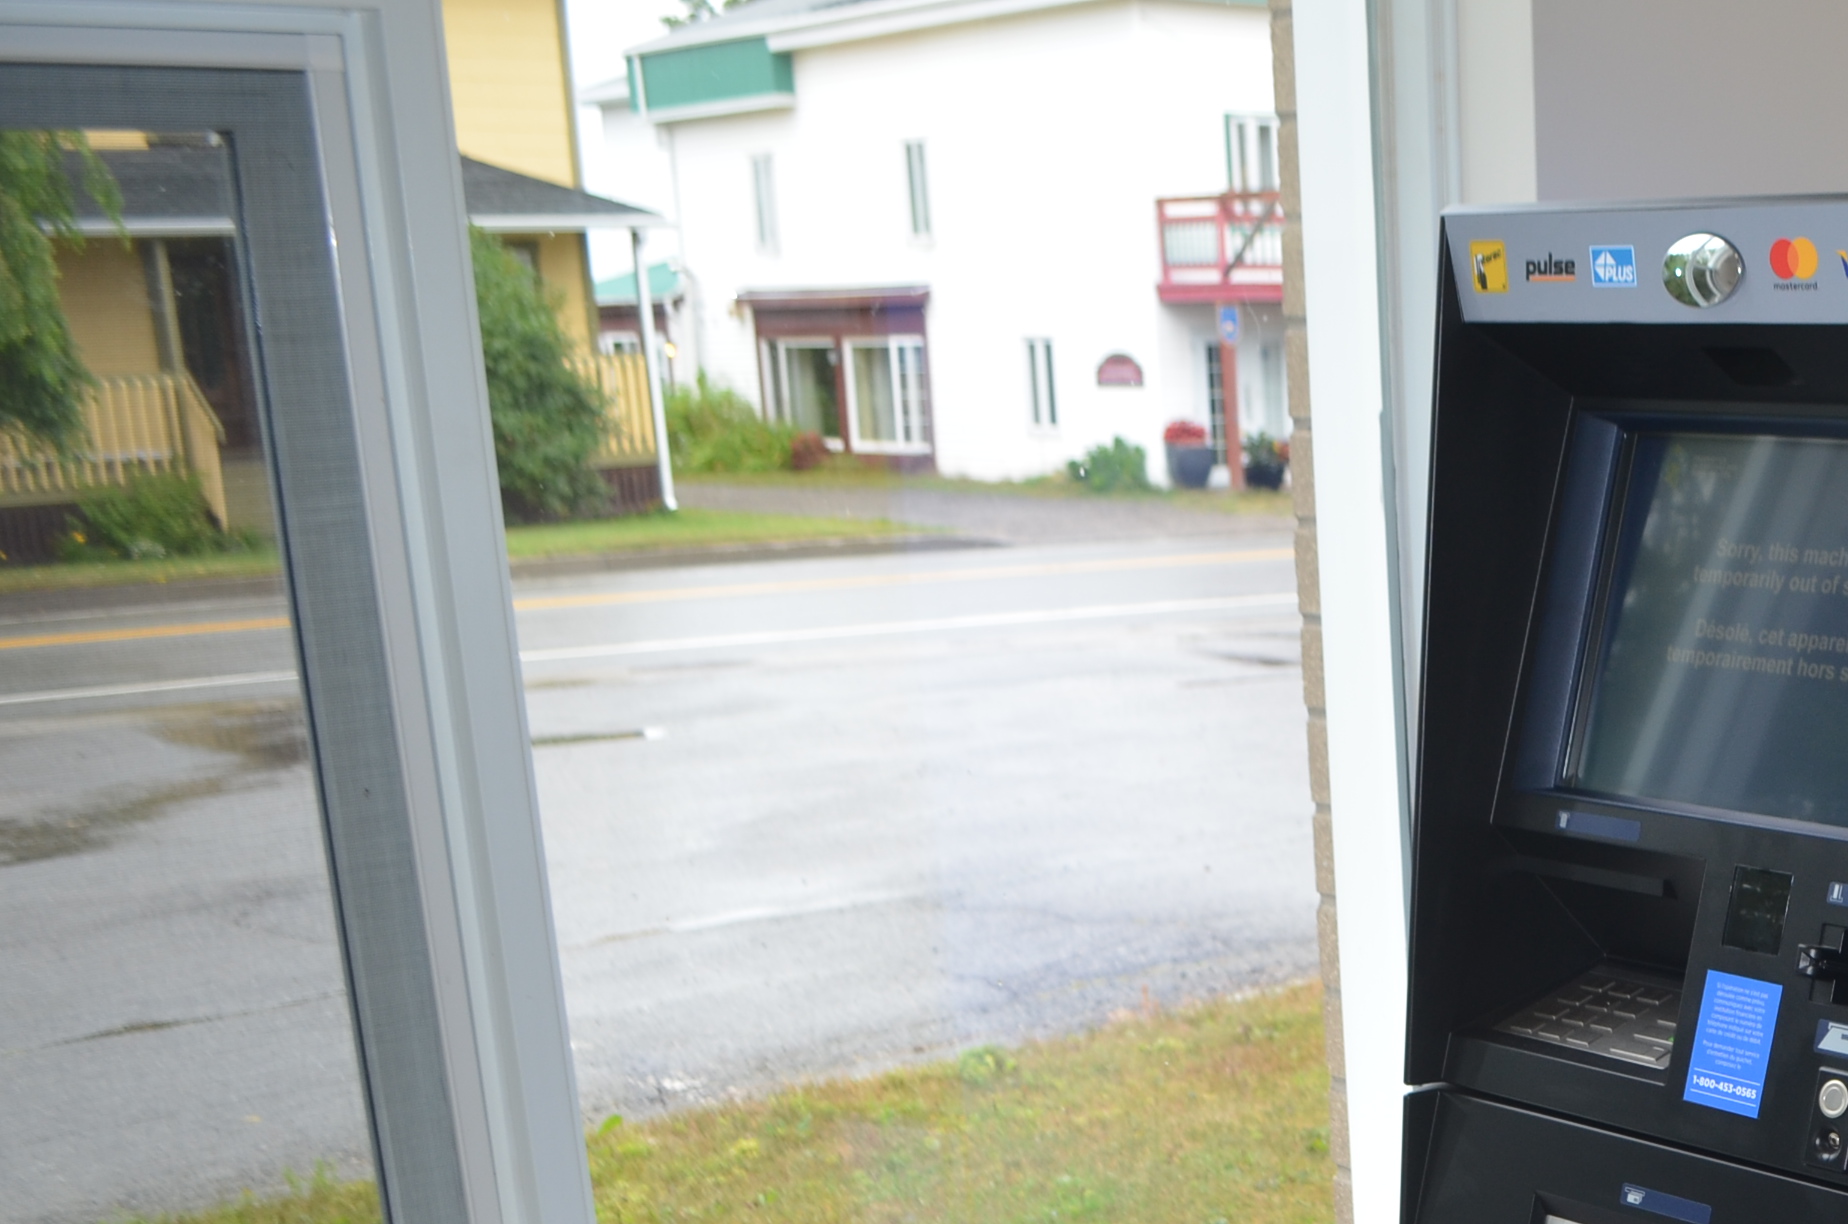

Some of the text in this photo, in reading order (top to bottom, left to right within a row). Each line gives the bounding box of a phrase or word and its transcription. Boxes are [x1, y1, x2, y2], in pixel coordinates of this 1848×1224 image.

[1526, 252, 1575, 282] pulse
[1605, 265, 1634, 281] PLUS
[1773, 282, 1818, 291] mastercard
[1716, 538, 1762, 563] Sorry,
[1768, 542, 1799, 563] this
[1693, 565, 1785, 595] temporarily
[1789, 574, 1817, 593] out
[1821, 575, 1842, 594] of
[1758, 627, 1785, 646] cet
[1666, 645, 1794, 676] temporairement
[1796, 657, 1835, 681] hors
[1692, 1074, 1757, 1099] 1-800-453-0565
